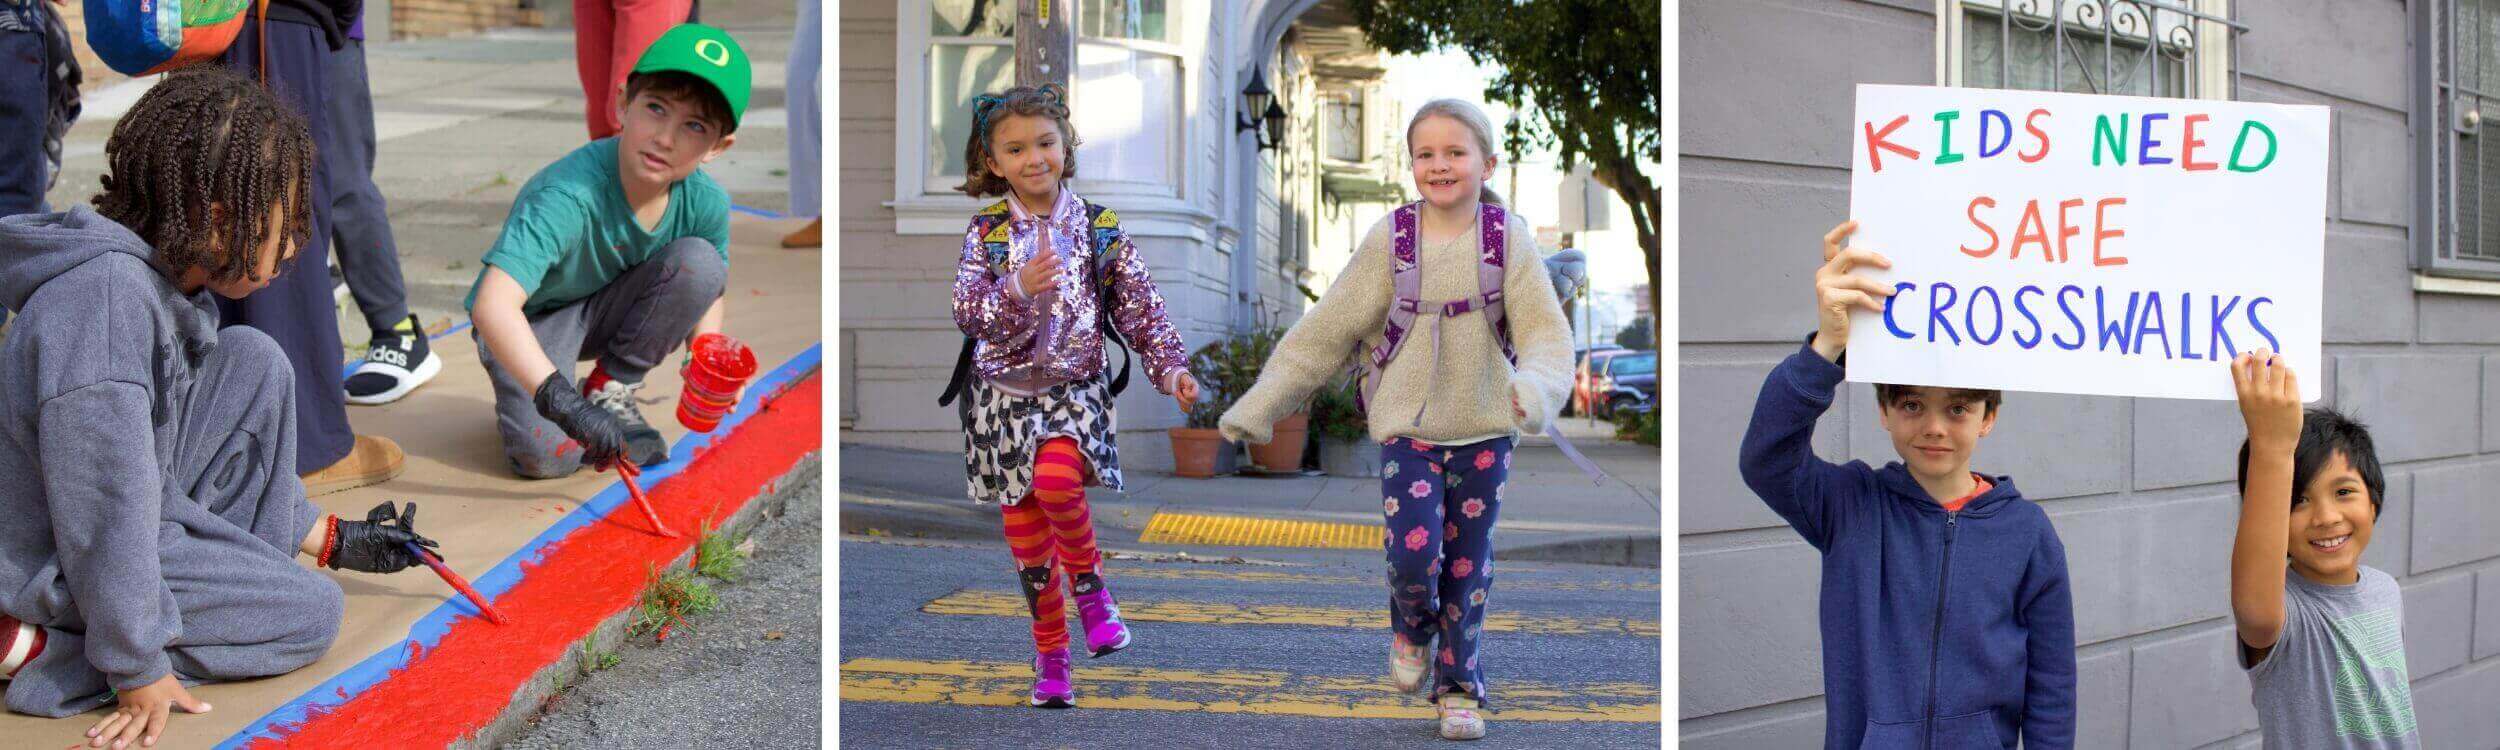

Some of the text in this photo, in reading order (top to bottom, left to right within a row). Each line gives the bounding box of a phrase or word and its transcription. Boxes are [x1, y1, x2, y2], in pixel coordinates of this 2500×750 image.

[695, 39, 729, 67] O
[1865, 109, 2278, 172] KIDS NEED
[1960, 197, 2129, 267] SAFE
[1883, 282, 2280, 363] CROSSWALKS
